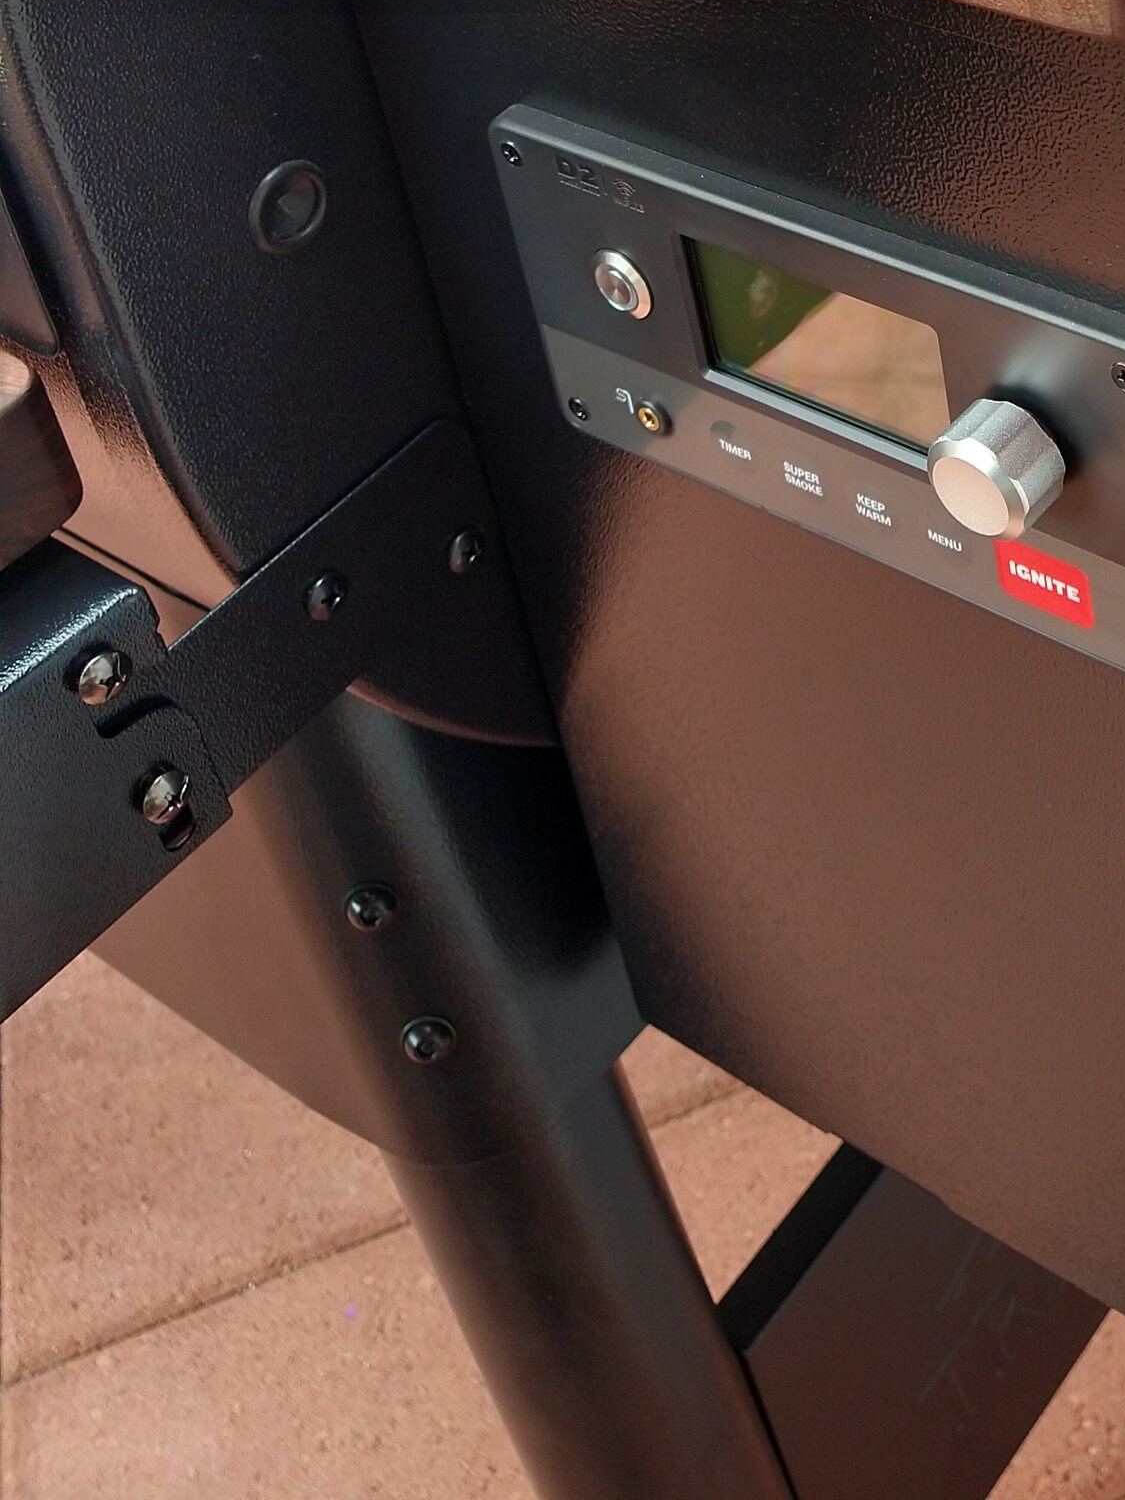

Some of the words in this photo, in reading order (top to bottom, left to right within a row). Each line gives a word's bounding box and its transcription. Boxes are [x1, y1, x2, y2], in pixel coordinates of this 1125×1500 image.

[719, 439, 752, 461] TIMER
[783, 461, 819, 484] SUPER
[784, 473, 824, 497] SMOKE
[857, 493, 886, 513] KEEP
[856, 503, 892, 527] WARM
[928, 529, 962, 552] MENU
[1008, 560, 1081, 603] IGNITE
